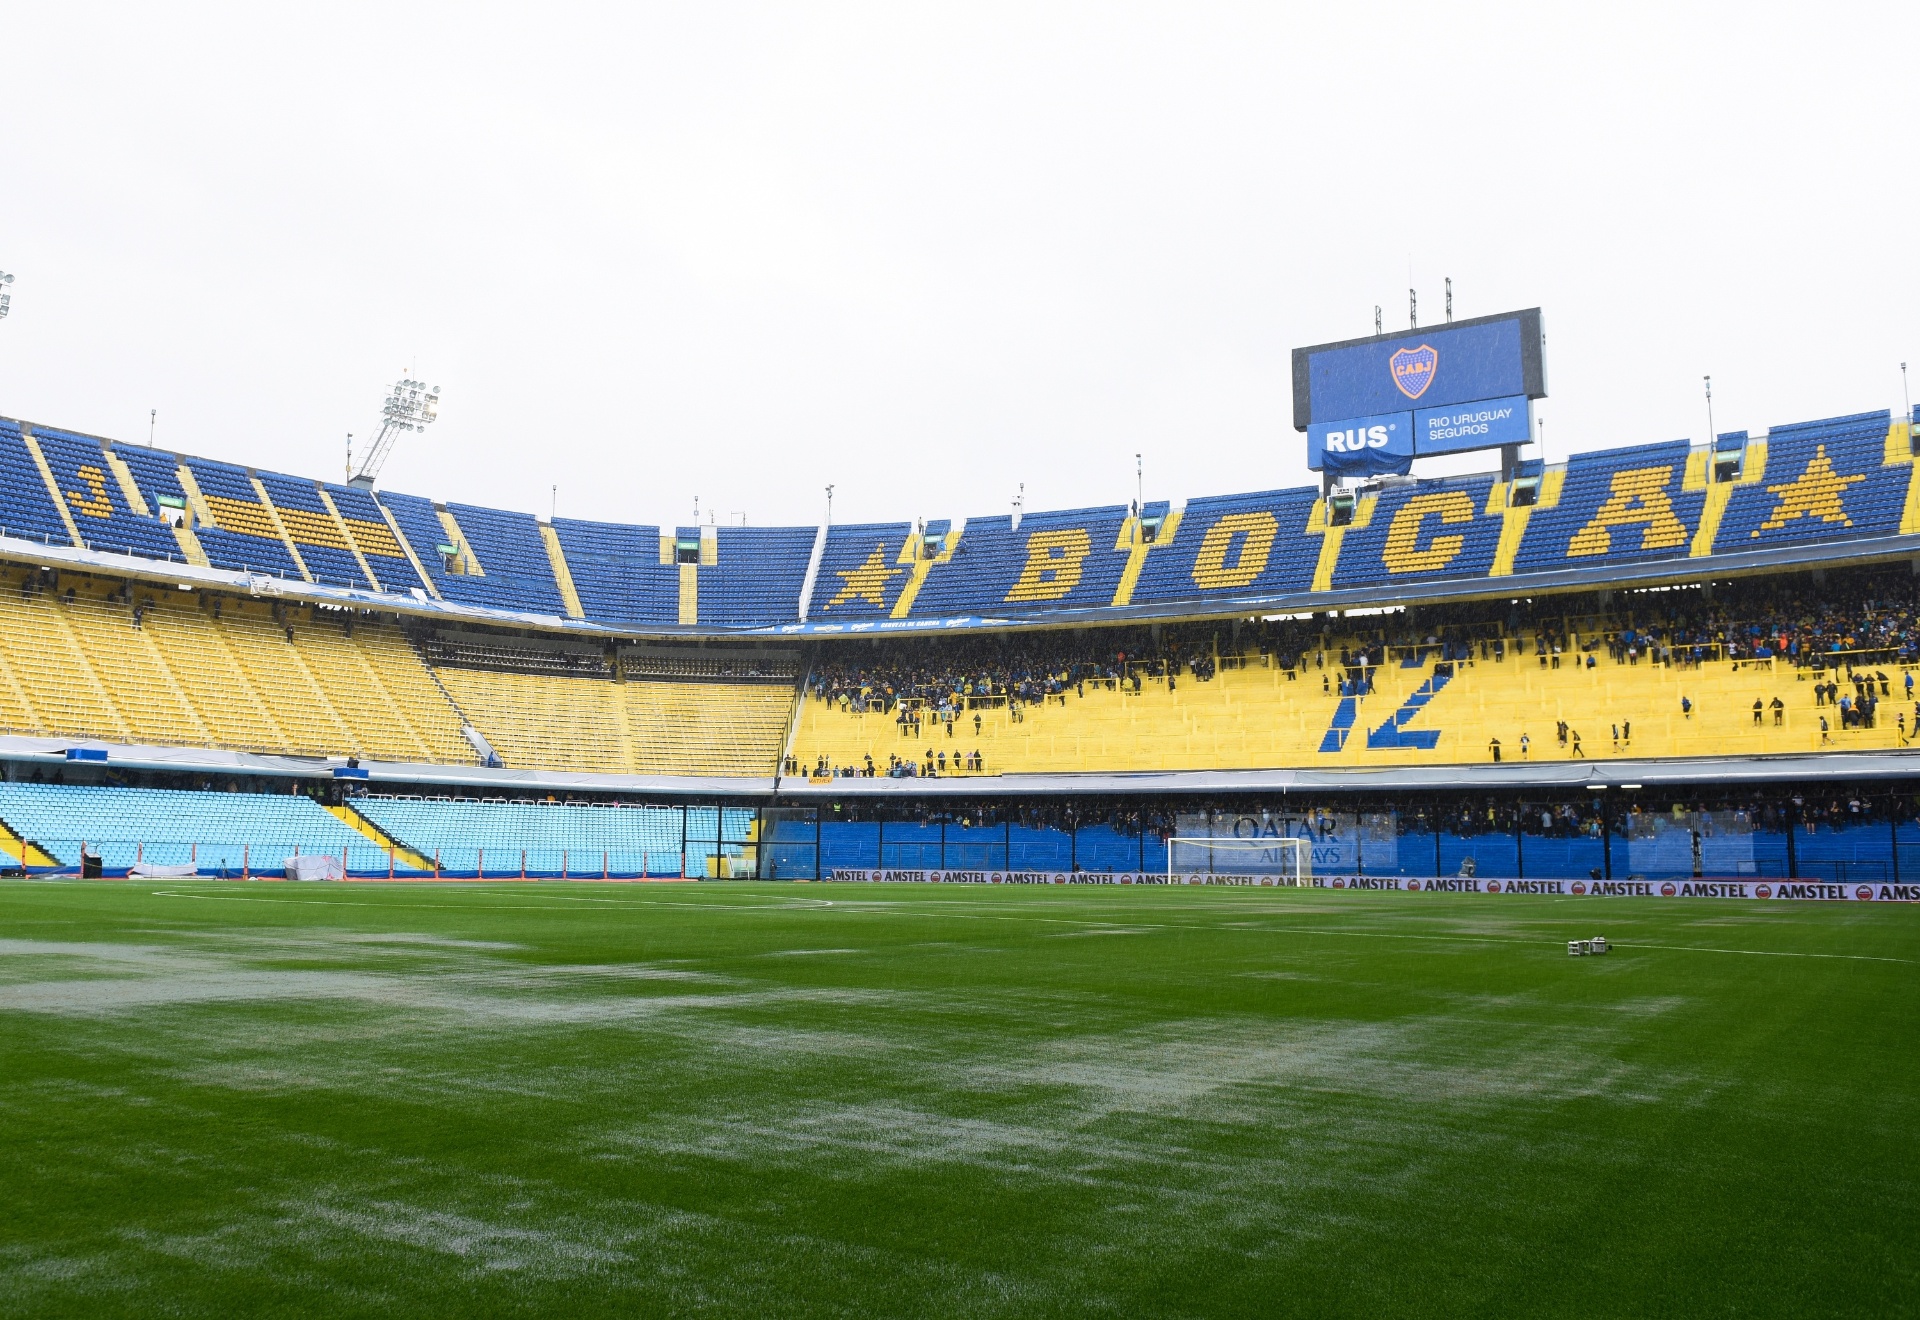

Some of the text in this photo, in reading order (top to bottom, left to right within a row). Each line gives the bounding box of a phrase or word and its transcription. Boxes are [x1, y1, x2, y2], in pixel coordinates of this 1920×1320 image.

[1428, 408, 1513, 428] RIO URUGUAY
[1326, 425, 1388, 453] RUS
[1429, 424, 1489, 440] SEGUROS
[1233, 817, 1339, 848] QATAR
[1260, 847, 1340, 864] AIRWAYS
[884, 871, 926, 883] AMSTEL
[943, 872, 987, 883] AMSTEL
[1005, 873, 1049, 884] AMSTEL
[1069, 873, 1115, 885] AMSTEL
[1205, 875, 1254, 886] AMSTEL
[1349, 877, 1401, 890] AMSTEL
[1424, 879, 1481, 892] AMSTEL
[1505, 880, 1565, 894] AMSTEL
[1590, 882, 1654, 896] AMSTEL
[1681, 883, 1748, 898] AMSTEL
[1777, 884, 1848, 899] AMSTEL
